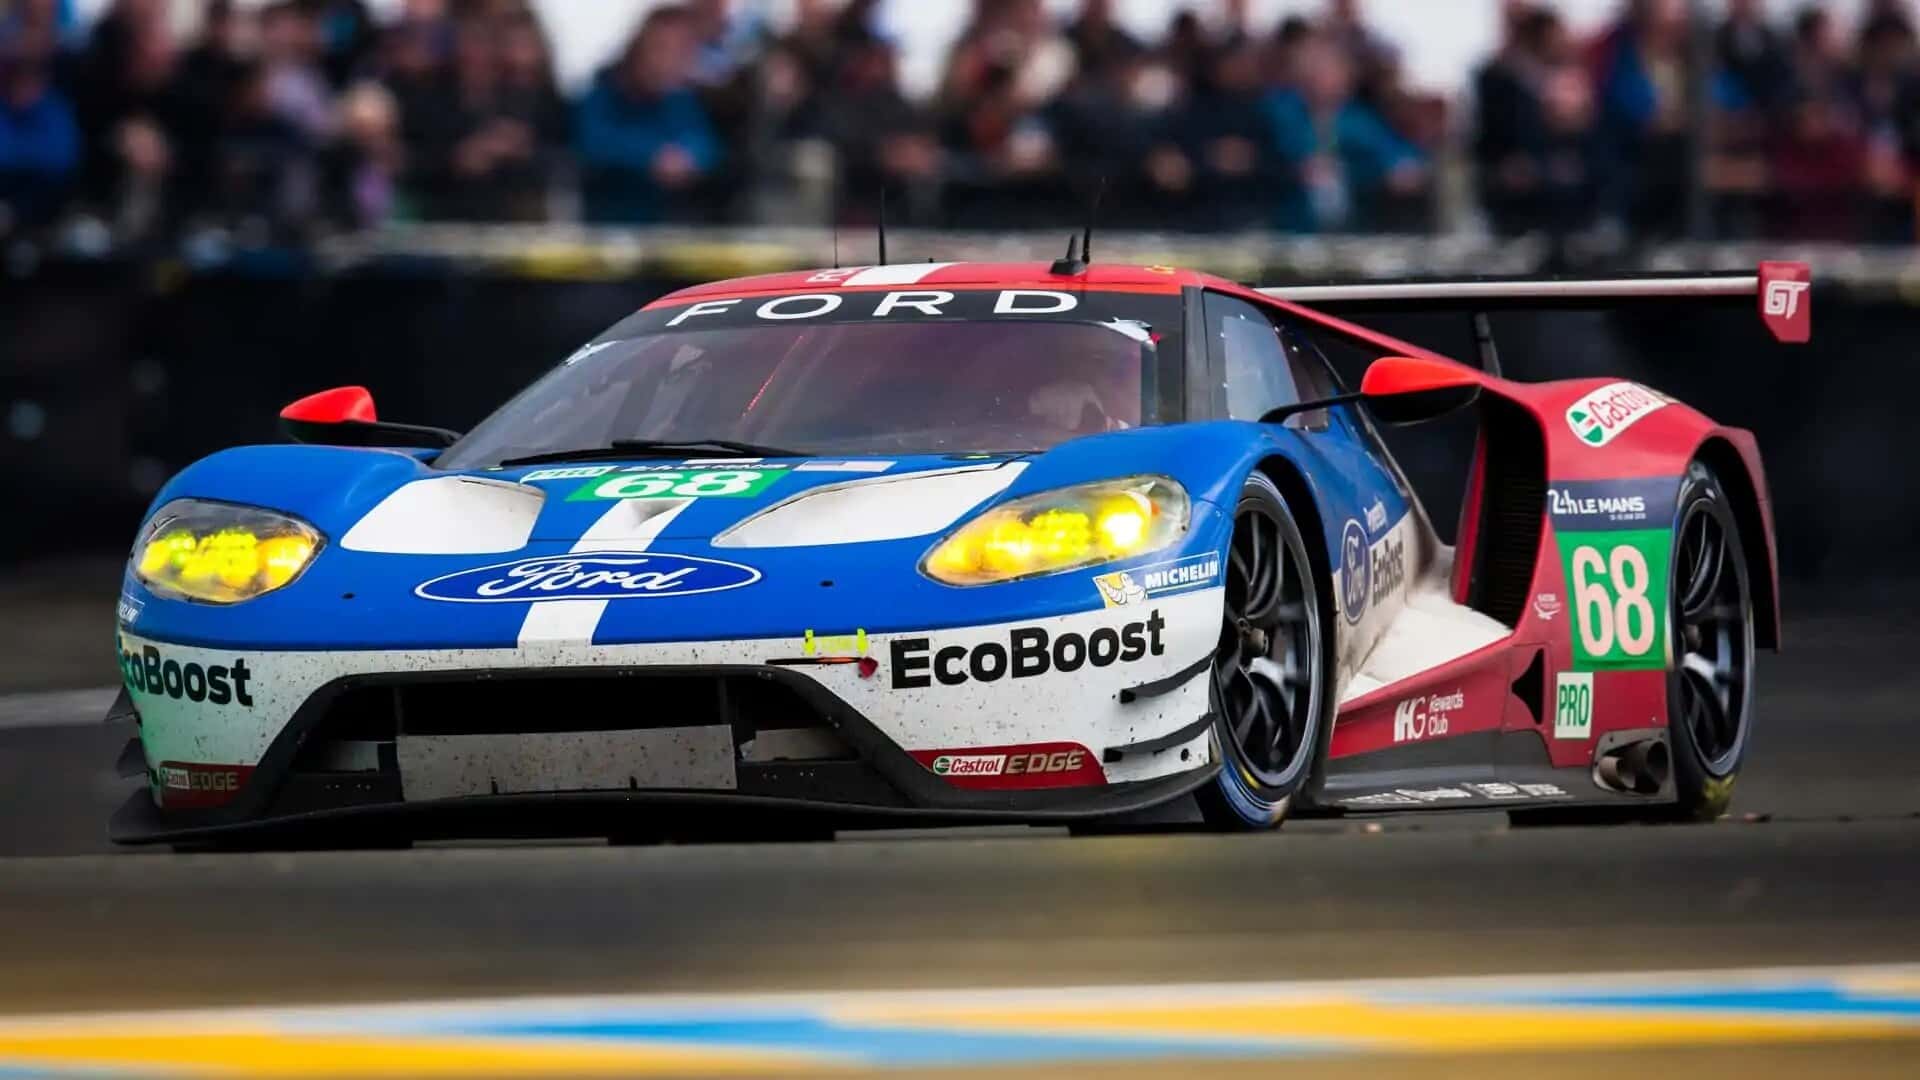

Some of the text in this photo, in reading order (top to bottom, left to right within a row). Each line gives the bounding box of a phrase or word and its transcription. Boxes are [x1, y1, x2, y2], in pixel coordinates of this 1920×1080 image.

[666, 290, 1078, 326] FORD
[1764, 280, 1810, 319] GT
[594, 472, 763, 498] 68
[1578, 498, 1598, 514] LE
[1597, 496, 1646, 513] MANS
[476, 558, 698, 596] Ford
[1144, 559, 1220, 589] MICHELIN
[1572, 544, 1656, 657] 68
[889, 608, 1166, 689] EcoBoost
[117, 640, 254, 707] coBoost
[1557, 683, 1591, 727] PRO
[950, 751, 1086, 777] Castrol EDGE
